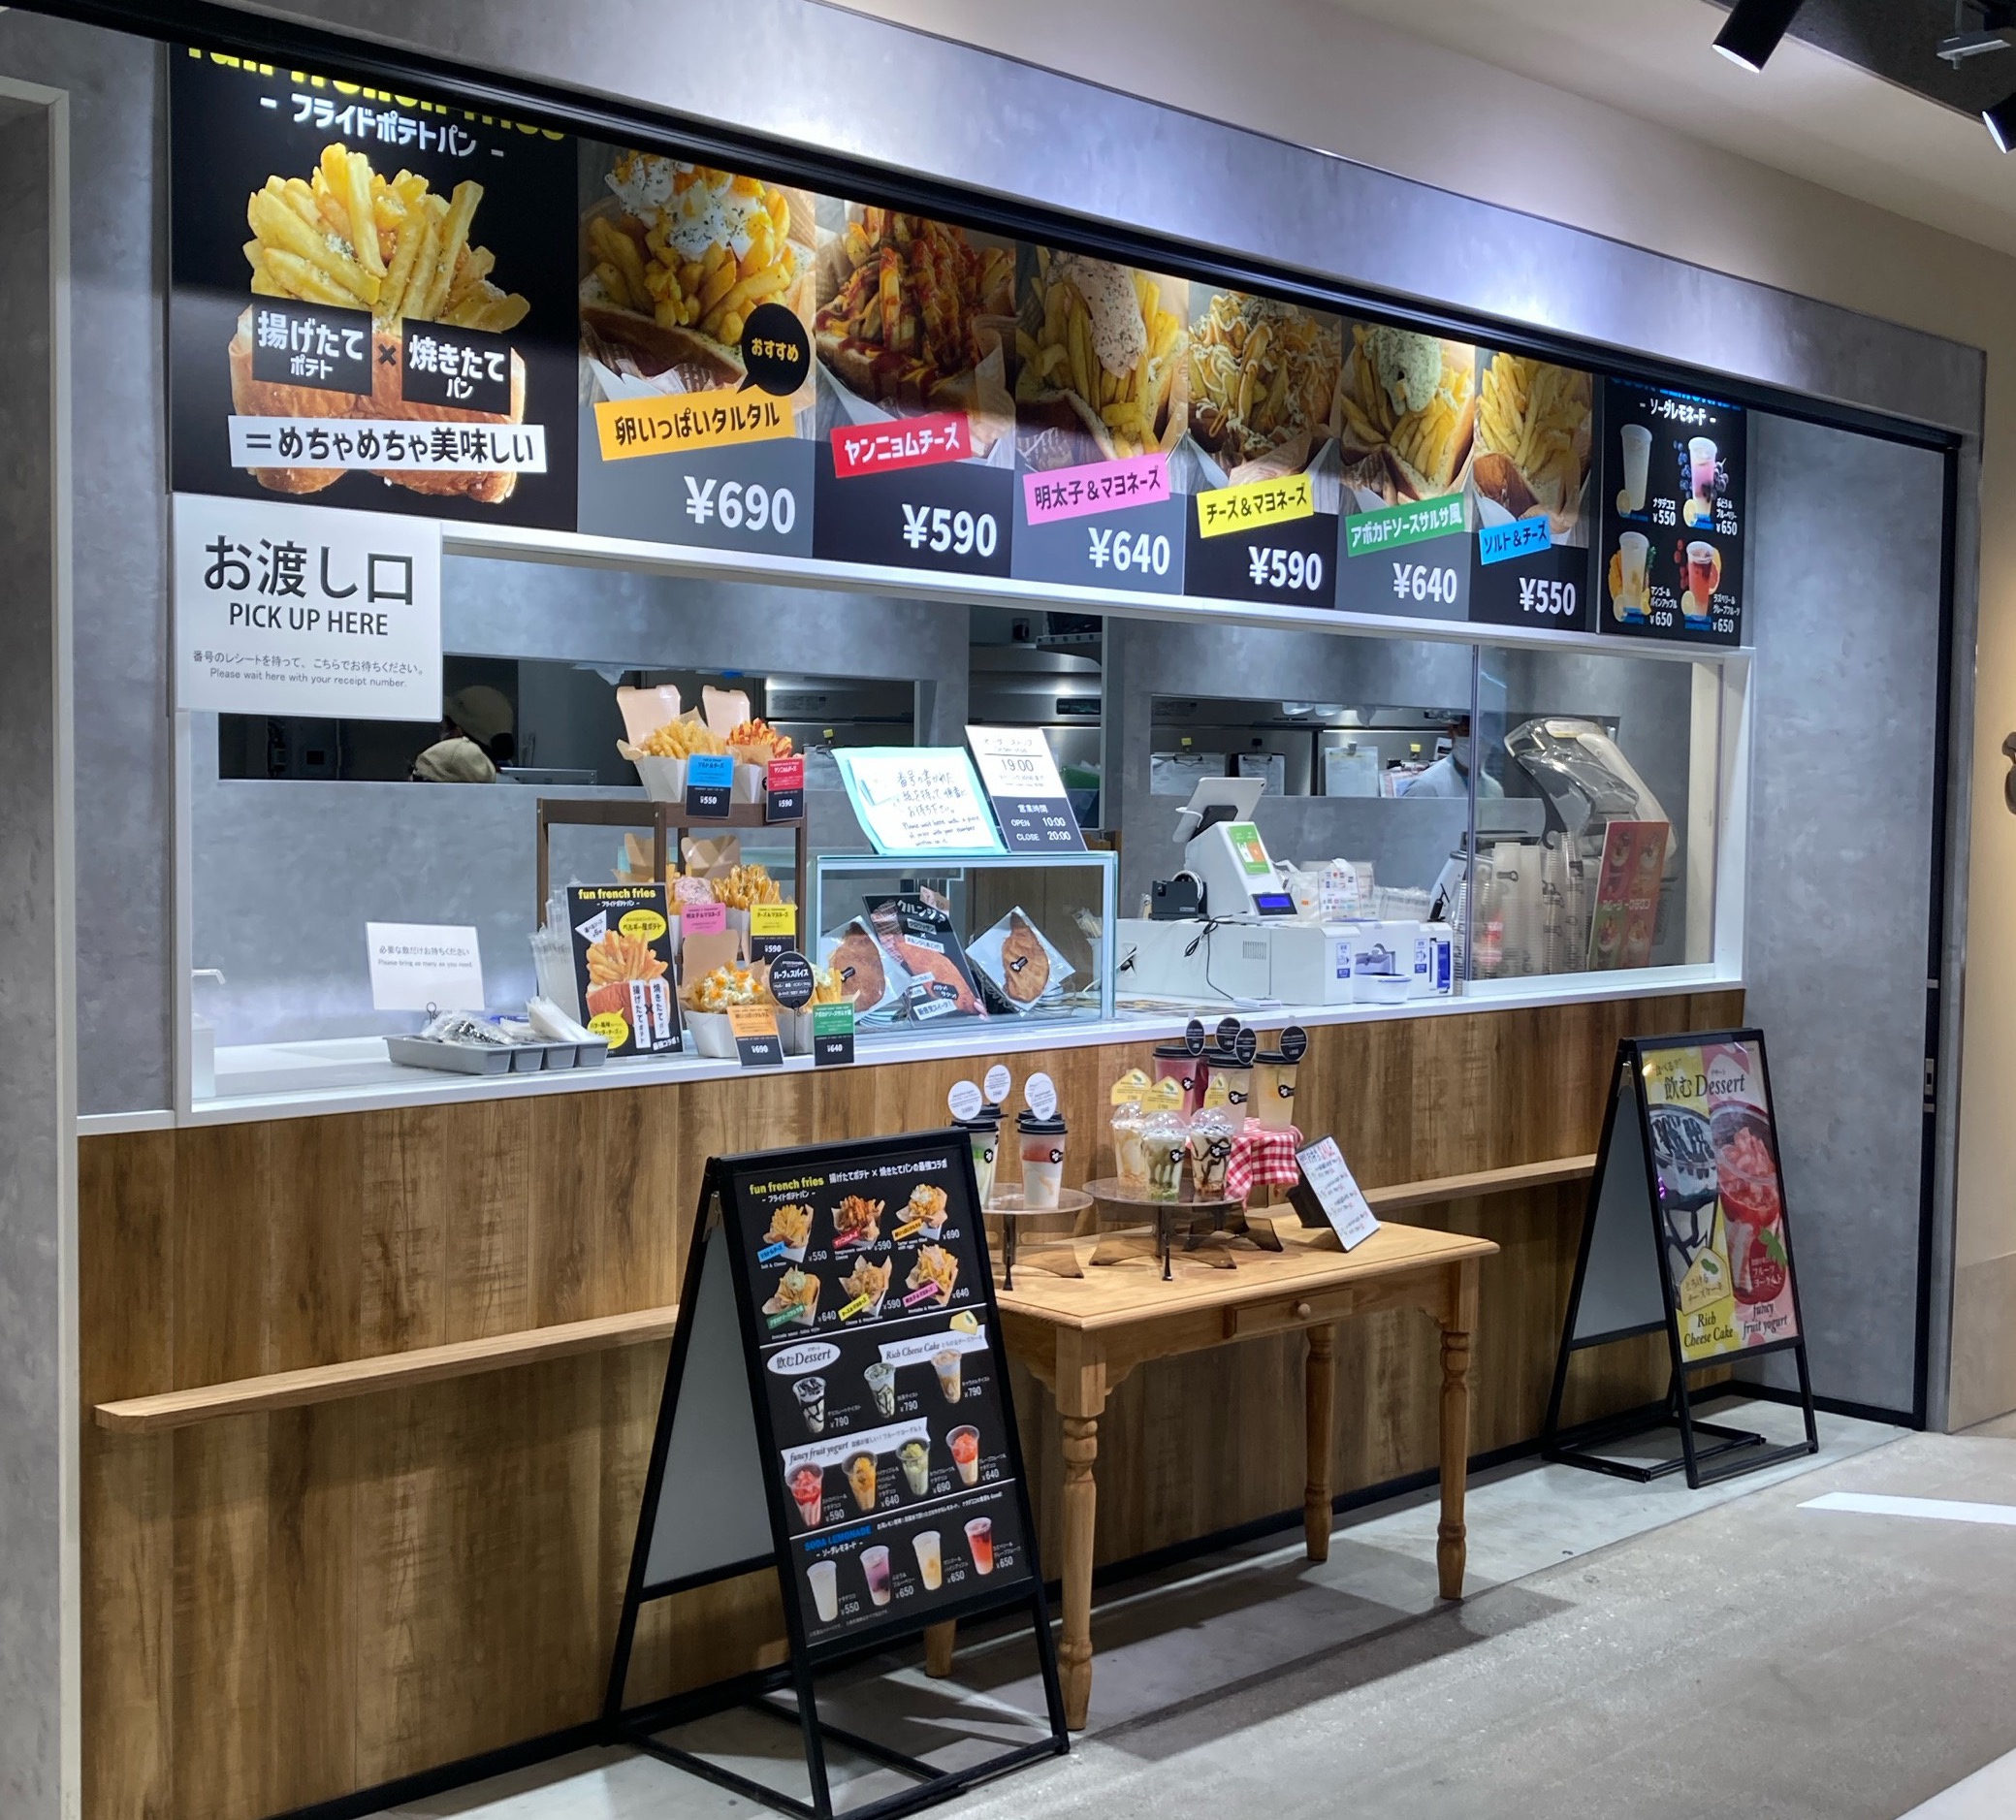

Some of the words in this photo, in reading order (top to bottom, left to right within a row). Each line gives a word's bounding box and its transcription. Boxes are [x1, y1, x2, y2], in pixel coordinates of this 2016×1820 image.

[291, 93, 476, 156] フライドポテトパン
[257, 310, 364, 362] 揚げたて
[409, 335, 506, 381] 焼きたて
[751, 337, 799, 363] おすすめ
[290, 356, 333, 380] ポテト
[447, 378, 473, 399] パン
[1650, 398, 1707, 426] ソーダレモネード
[615, 402, 780, 446] 卵いっぱいタルタル
[845, 421, 960, 466] ヤンニョムチーズ
[684, 474, 795, 534] ¥690
[1653, 497, 1676, 510] ナタデココ
[1351, 502, 1462, 548] アボカドソースサルサ風
[1652, 511, 1676, 527] ¥550
[901, 503, 998, 557] ¥590
[1716, 521, 1738, 535] ¥650
[1088, 527, 1170, 575] ¥640
[205, 534, 413, 606] お渡し口
[1248, 545, 1322, 591] ¥590
[1392, 562, 1457, 603] ¥640
[1520, 577, 1576, 616] ¥550
[230, 602, 282, 628] PICK
[289, 607, 320, 631] UP
[328, 610, 388, 636] HERE
[1649, 612, 1672, 626] ¥650
[1712, 619, 1734, 633] ¥650
[210, 667, 240, 679] Please
[243, 670, 262, 681] wait
[266, 671, 285, 682] here
[289, 672, 307, 683] with
[310, 675, 331, 686] your
[335, 675, 367, 686] receipt
[369, 677, 407, 687] number.
[1017, 804, 1048, 814] 営業時間
[1010, 818, 1031, 827] OPEN
[1042, 816, 1066, 826] 10:00
[1047, 831, 1071, 841] 20:00
[578, 888, 595, 900] fun
[597, 888, 630, 899] french
[632, 887, 656, 898] fries
[829, 1169, 870, 1184] 揚げたてポテト
[750, 1183, 766, 1195] fun
[768, 1179, 800, 1193] french
[800, 1176, 824, 1190] fries
[943, 1229, 960, 1240] ¥690
[874, 1240, 891, 1251] ¥590
[808, 1251, 827, 1261] ¥550
[952, 1288, 970, 1298] ¥640
[883, 1298, 901, 1310] ¥590
[817, 1311, 836, 1322] ¥640
[1698, 1311, 1716, 1327] Rich
[1742, 1322, 1762, 1341] fruit
[1762, 1315, 1787, 1335] yogurt
[1684, 1332, 1712, 1347] Cheese
[1713, 1325, 1734, 1341] Cake
[886, 1349, 902, 1360] Rich
[902, 1347, 923, 1357] Cheese
[924, 1342, 941, 1353] Cake
[964, 1387, 982, 1398] ¥790
[900, 1400, 918, 1413] ¥790
[830, 1417, 848, 1428] ¥790
[807, 1447, 826, 1462] fruit
[825, 1442, 848, 1456] yogurt
[982, 1469, 1000, 1481] ¥640
[932, 1482, 951, 1494] ¥690
[880, 1495, 900, 1508] ¥640
[825, 1509, 845, 1522] ¥590
[827, 1526, 871, 1546] LEMONADE
[996, 1556, 1013, 1569] ¥650
[946, 1570, 965, 1582] ¥650
[895, 1585, 913, 1598] ¥650
[841, 1603, 859, 1615] ¥550
